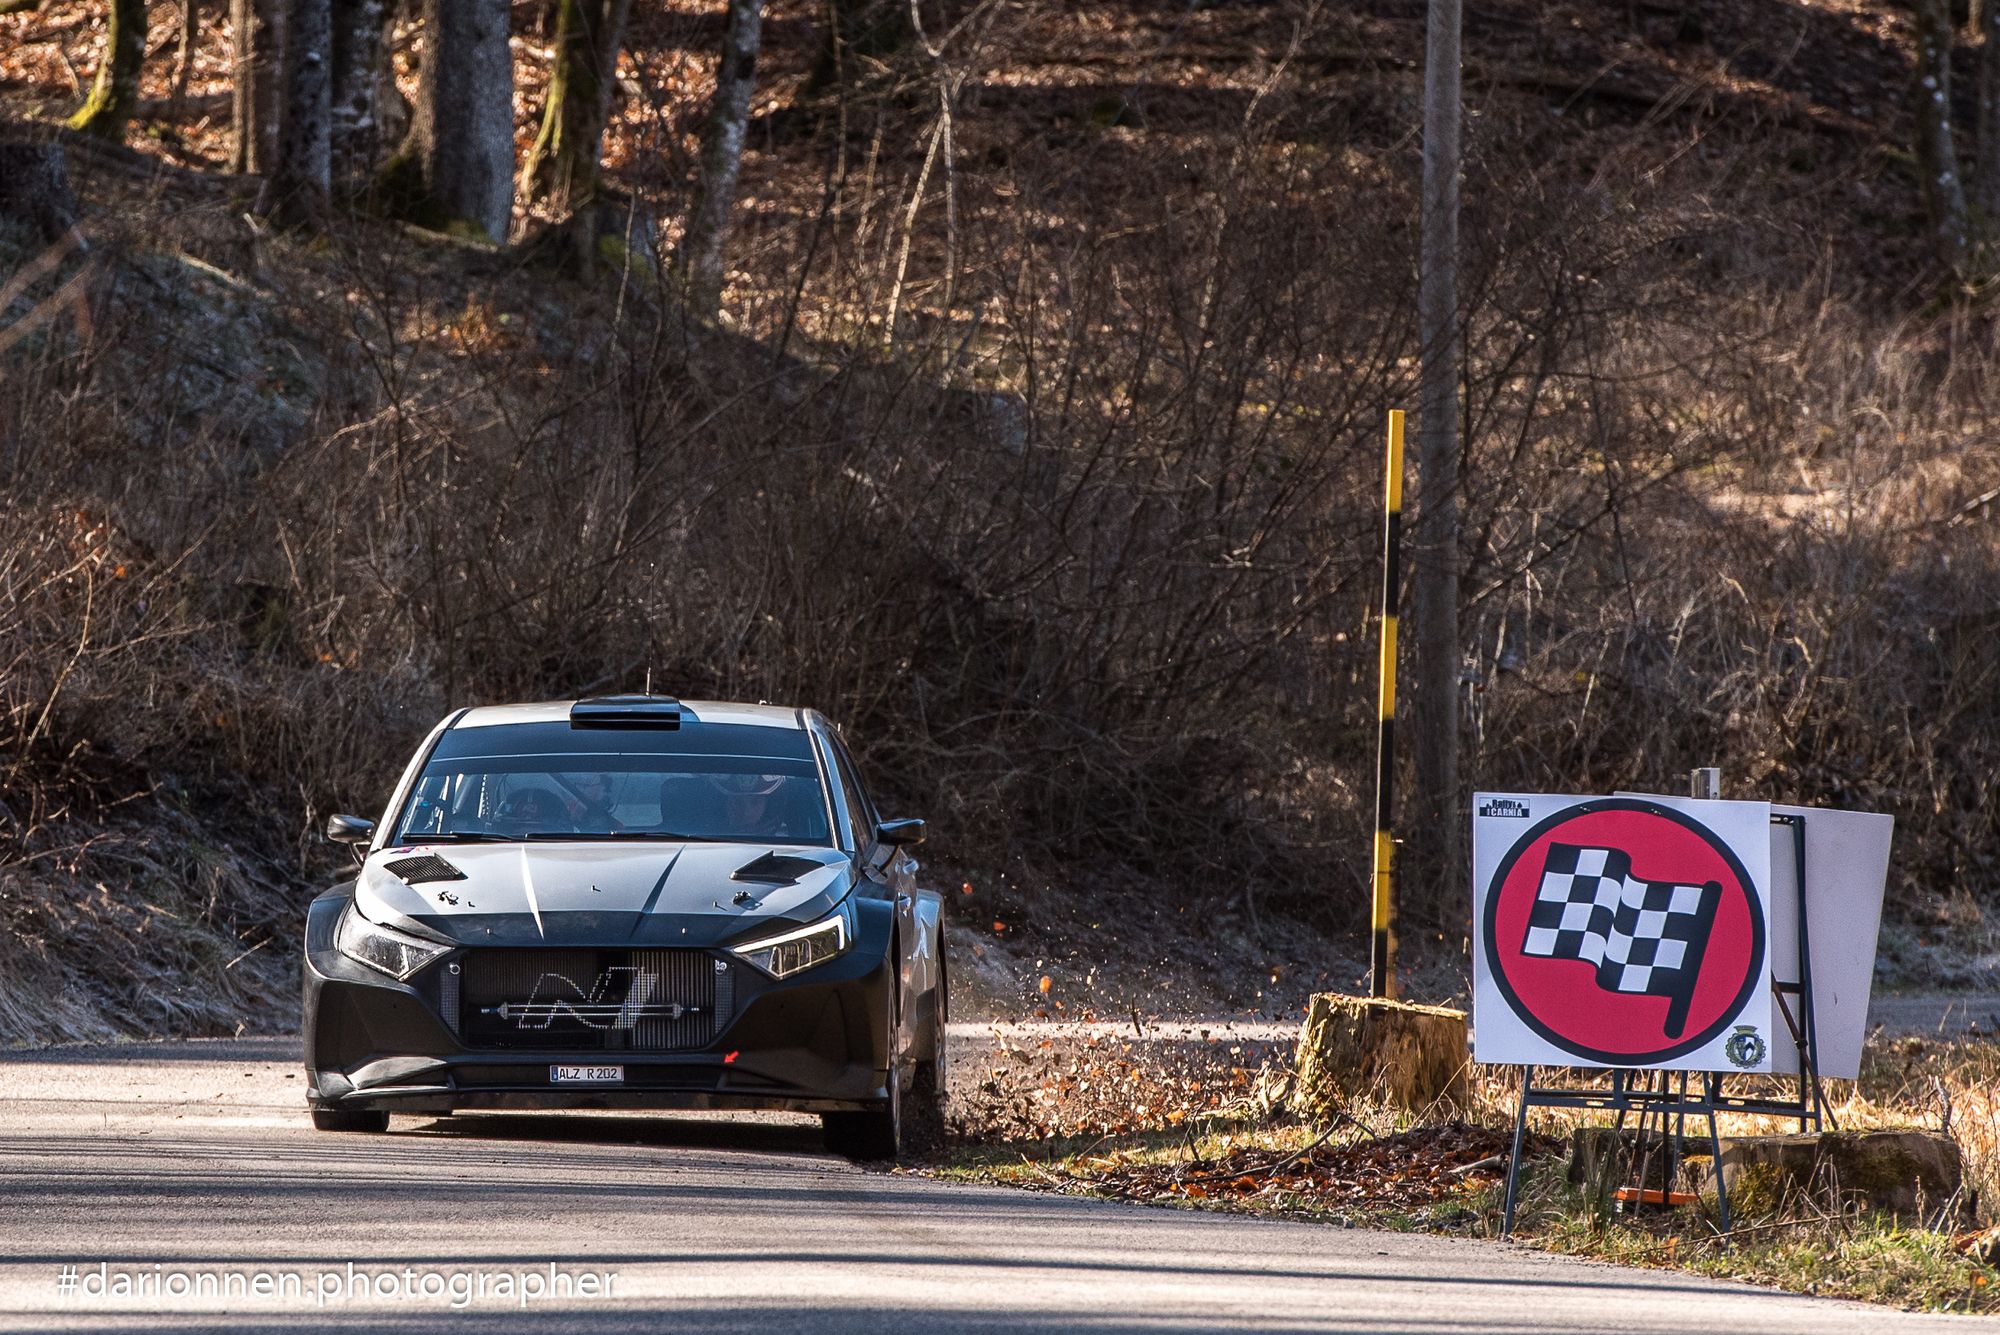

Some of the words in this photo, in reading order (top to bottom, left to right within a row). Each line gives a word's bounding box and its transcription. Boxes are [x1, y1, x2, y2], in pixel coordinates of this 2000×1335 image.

[1491, 808, 1523, 817] CARNIA
[559, 1068, 580, 1079] ALZ
[587, 1068, 595, 1079] R
[596, 1068, 617, 1079] 202
